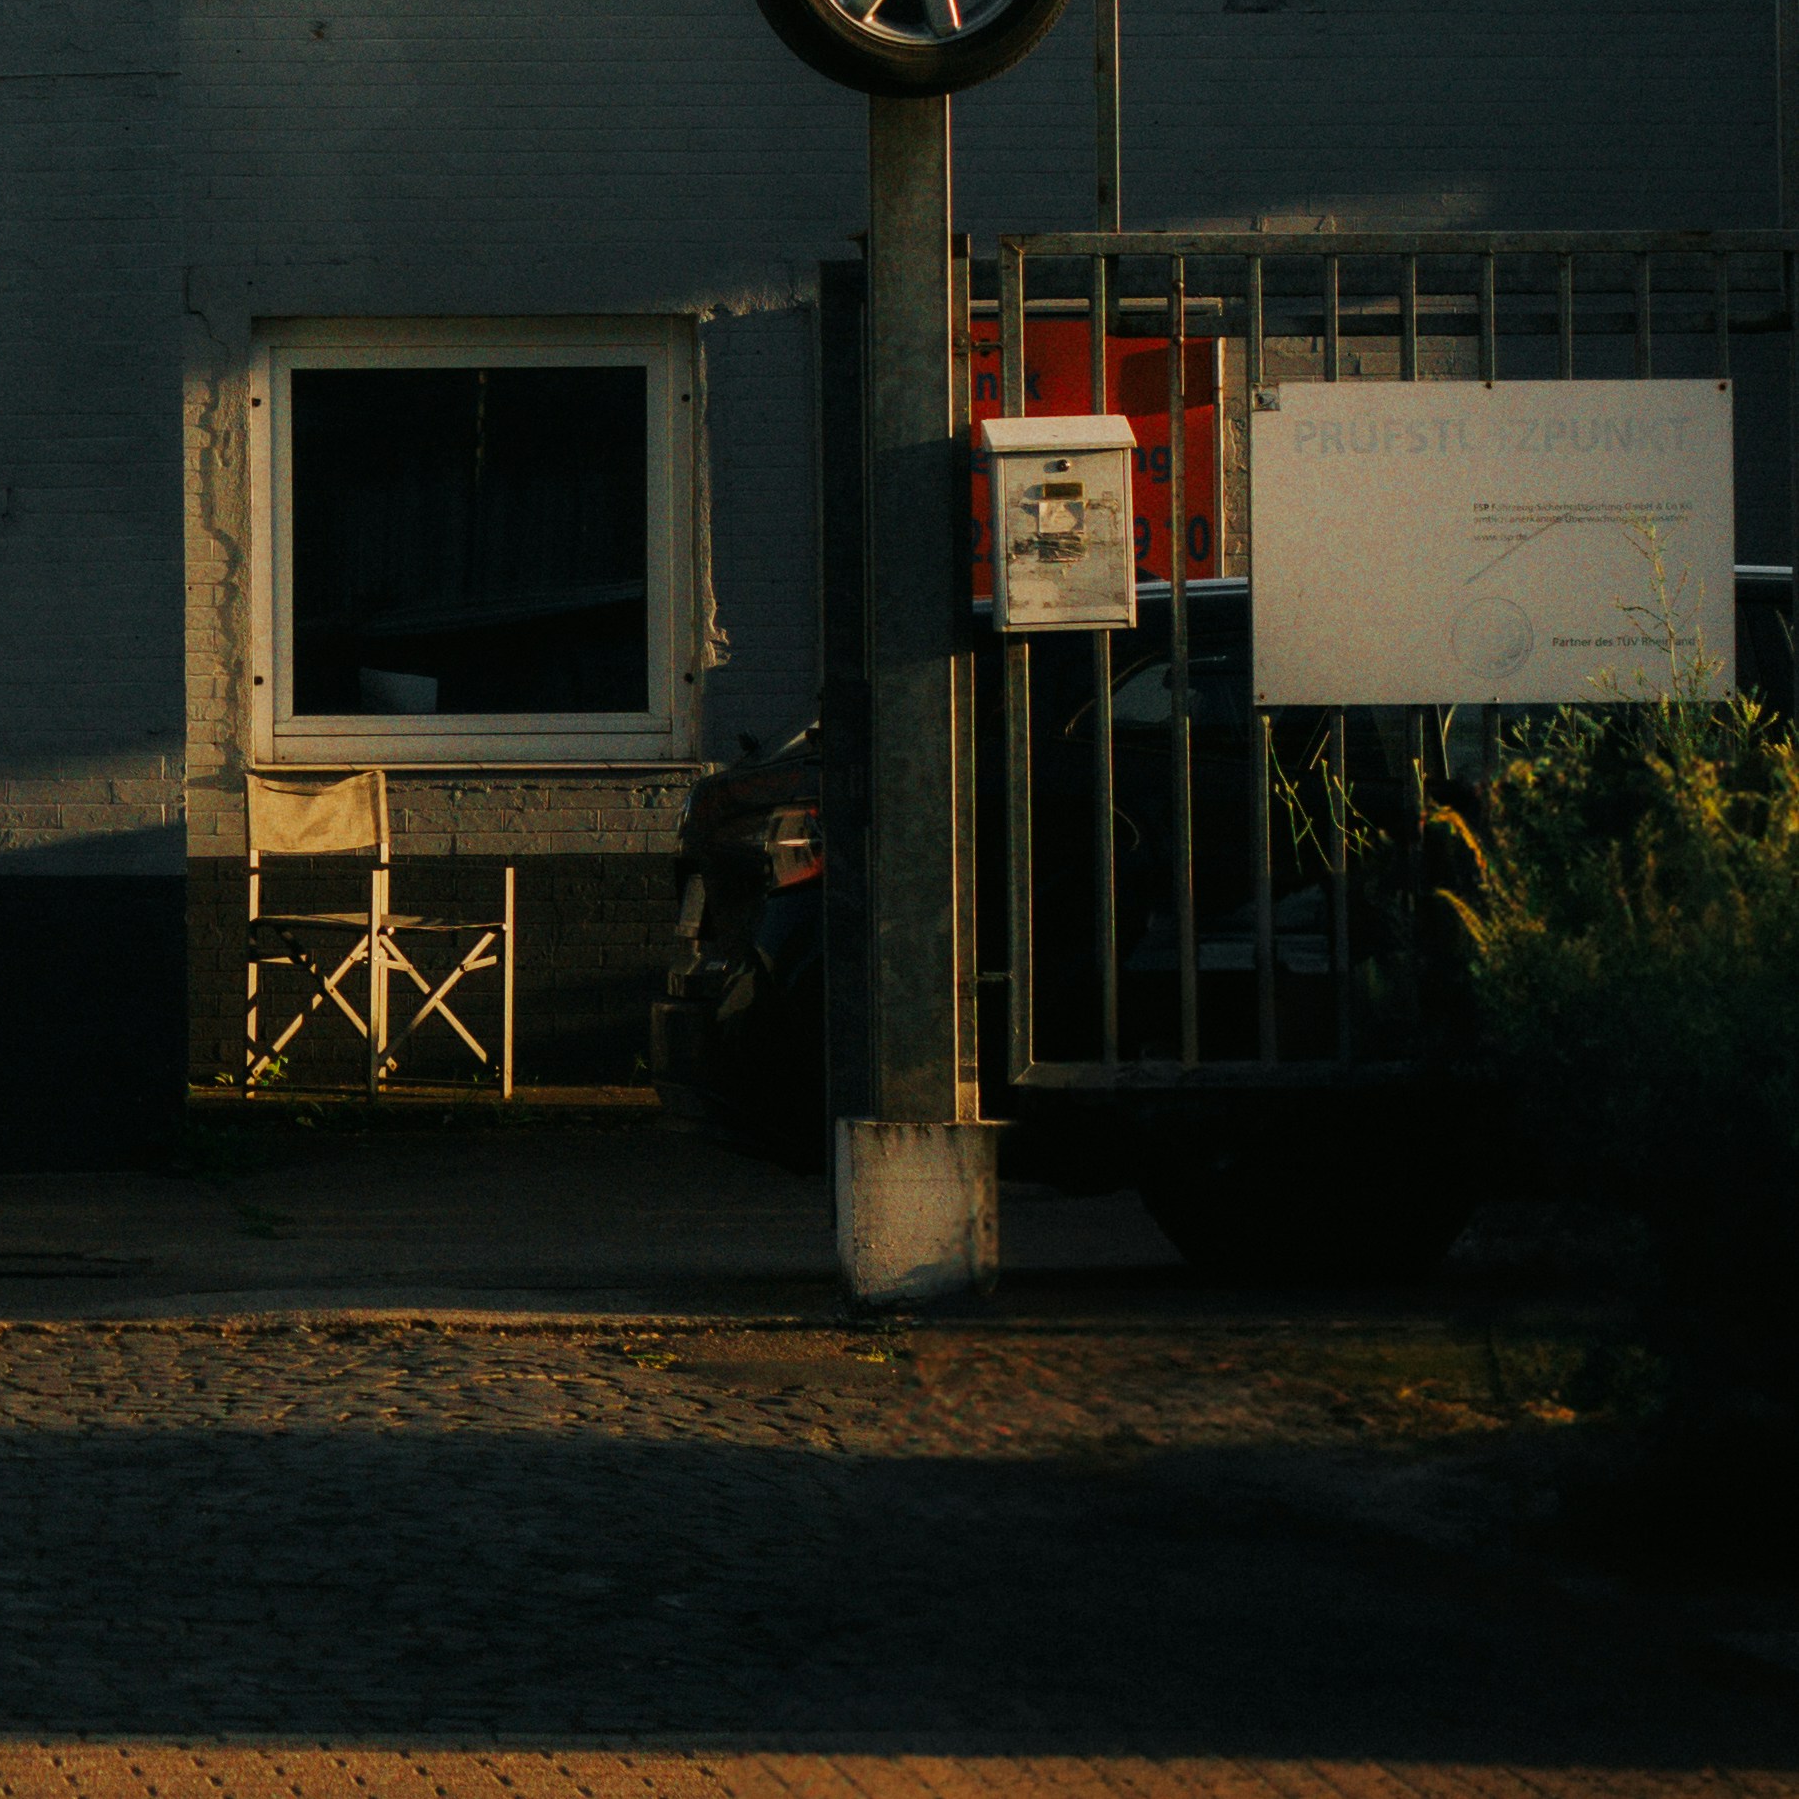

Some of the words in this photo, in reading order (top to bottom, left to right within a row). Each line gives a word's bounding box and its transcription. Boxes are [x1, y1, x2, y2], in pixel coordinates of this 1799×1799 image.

[1552, 637, 1591, 647] Partner
[1595, 636, 1613, 647] des
[1616, 635, 1638, 647] TÜV
[1642, 636, 1696, 647] Rheinand
